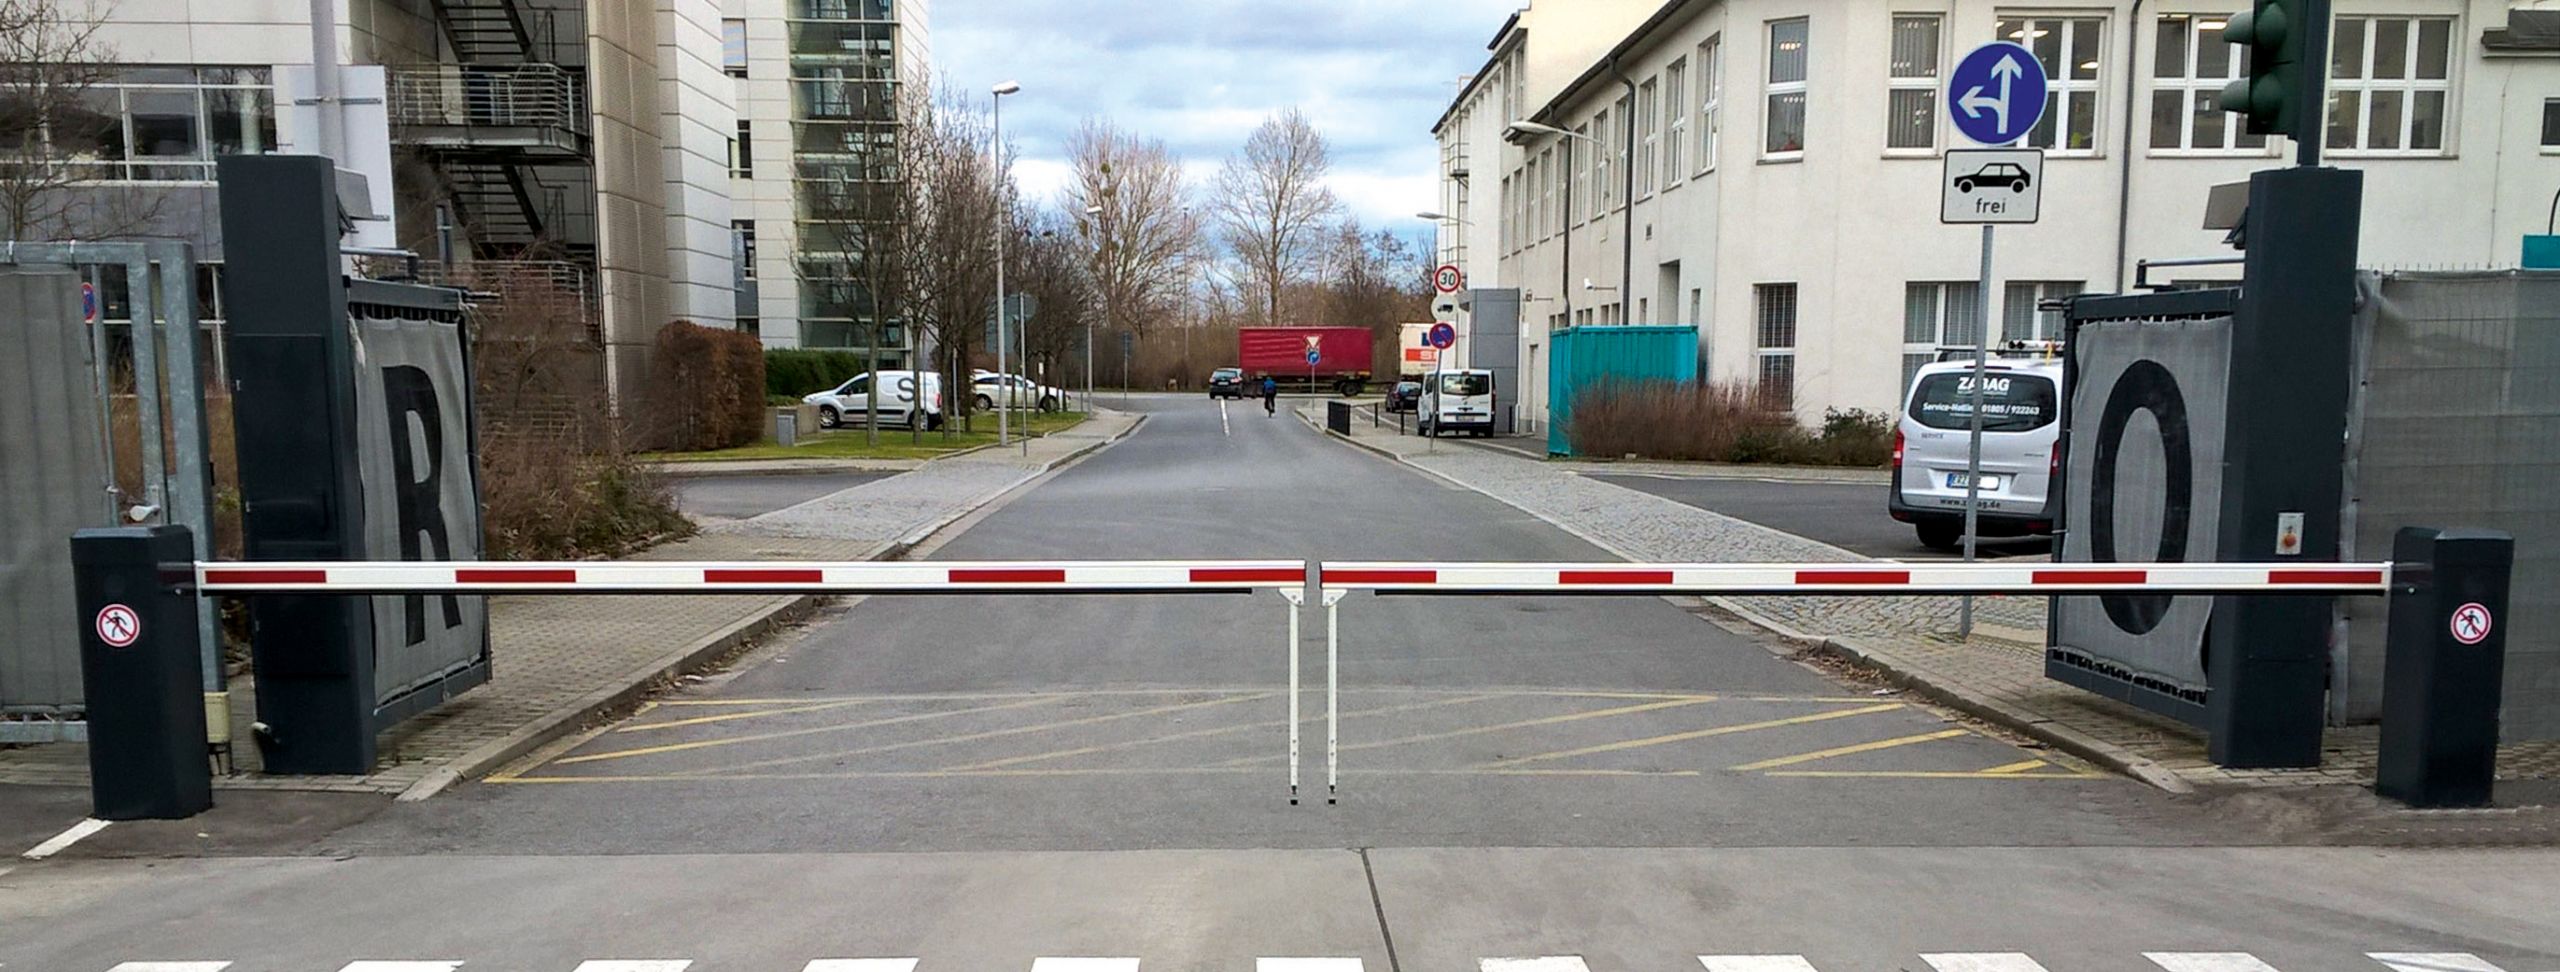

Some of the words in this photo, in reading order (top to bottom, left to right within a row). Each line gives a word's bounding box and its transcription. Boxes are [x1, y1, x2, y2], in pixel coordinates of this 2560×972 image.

[1976, 198, 2006, 213] frei
[1440, 272, 1456, 286] 30
[382, 365, 462, 647] R
